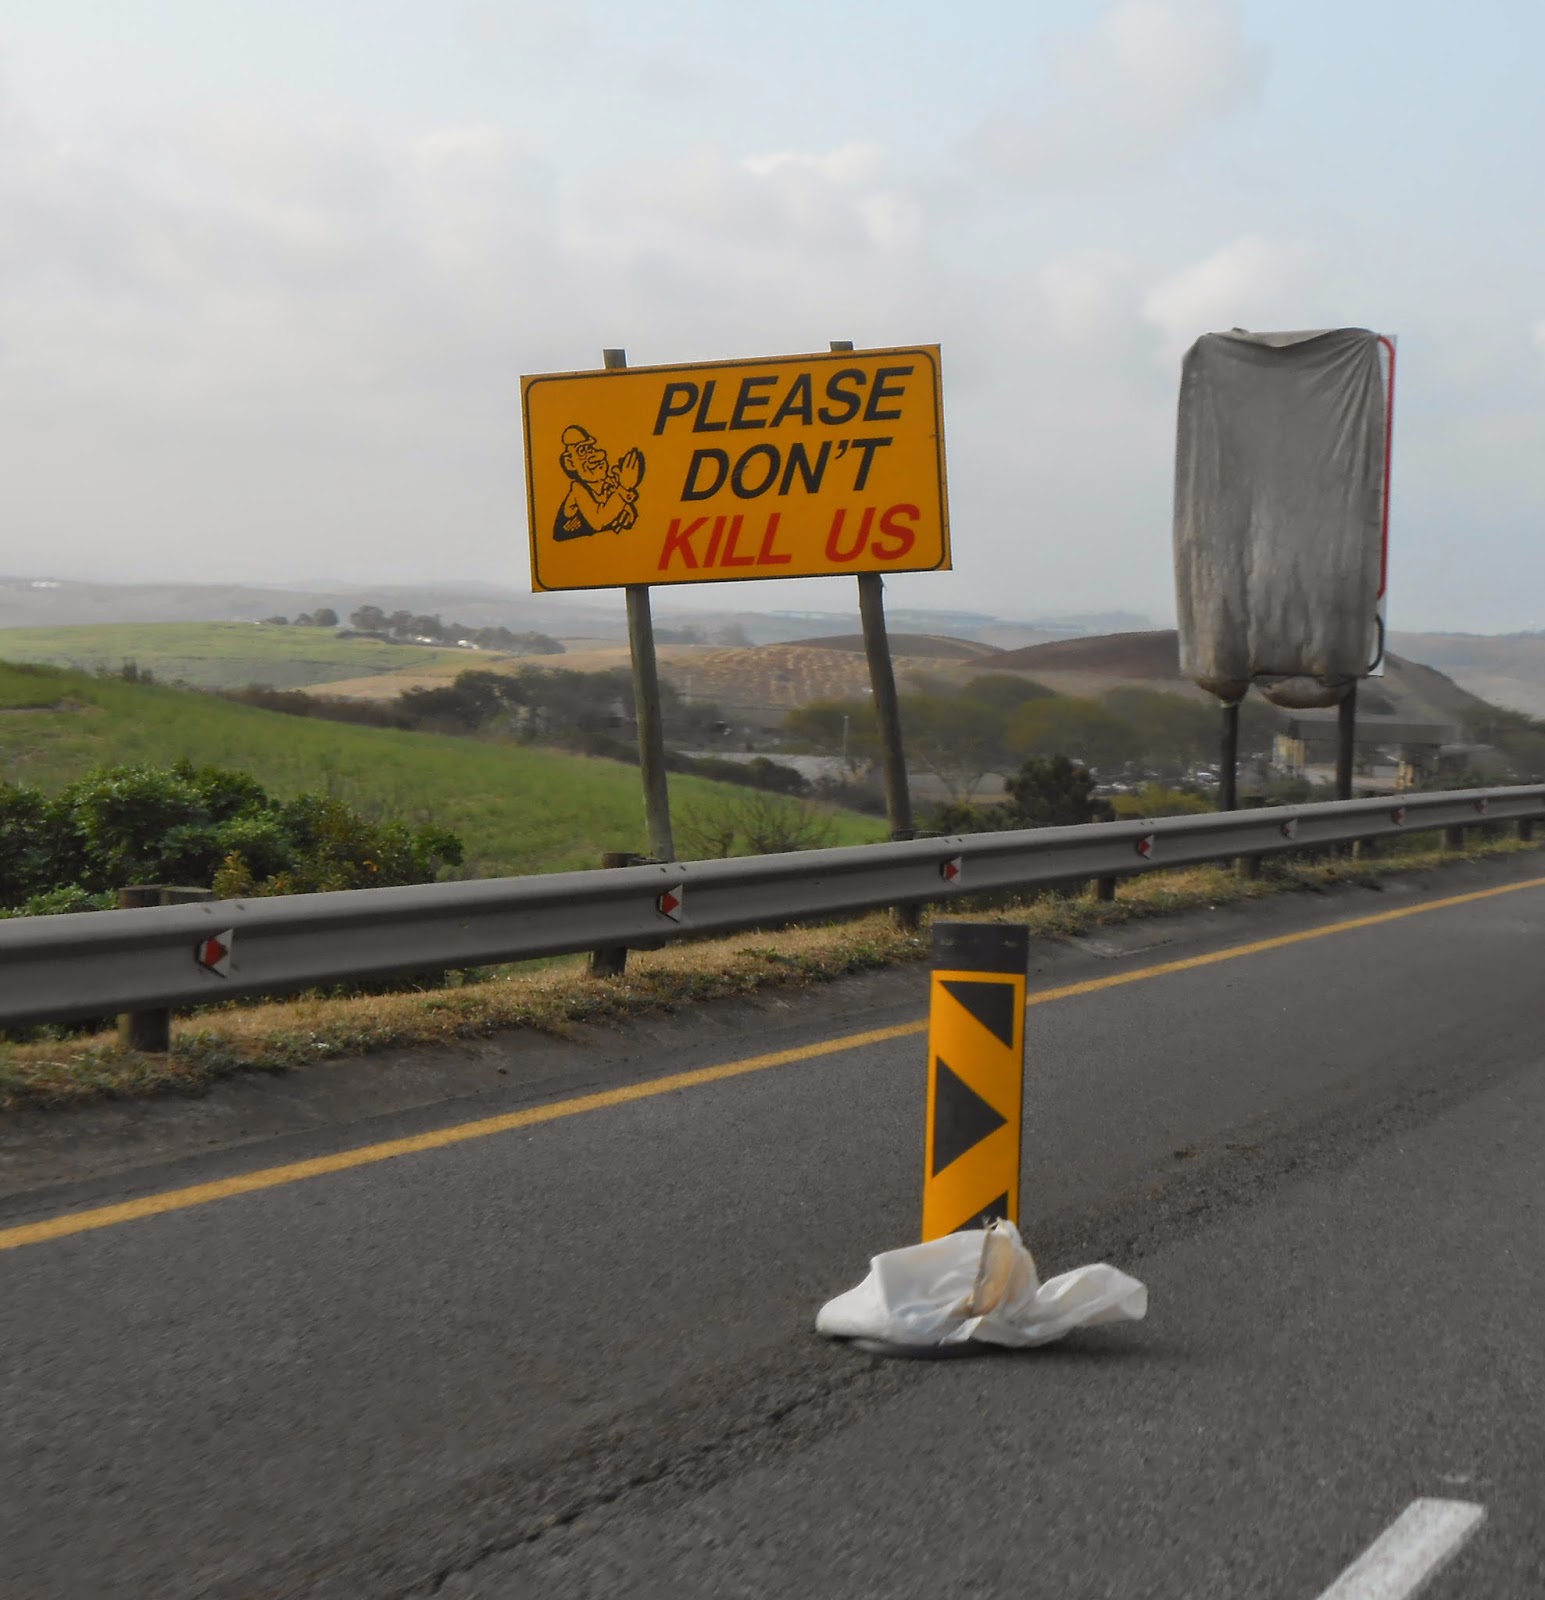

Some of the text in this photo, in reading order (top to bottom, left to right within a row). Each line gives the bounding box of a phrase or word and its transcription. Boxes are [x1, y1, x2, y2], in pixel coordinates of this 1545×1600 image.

[652, 365, 914, 436] PLEASE
[680, 437, 894, 502] DON'T
[656, 503, 921, 571] KILL US
